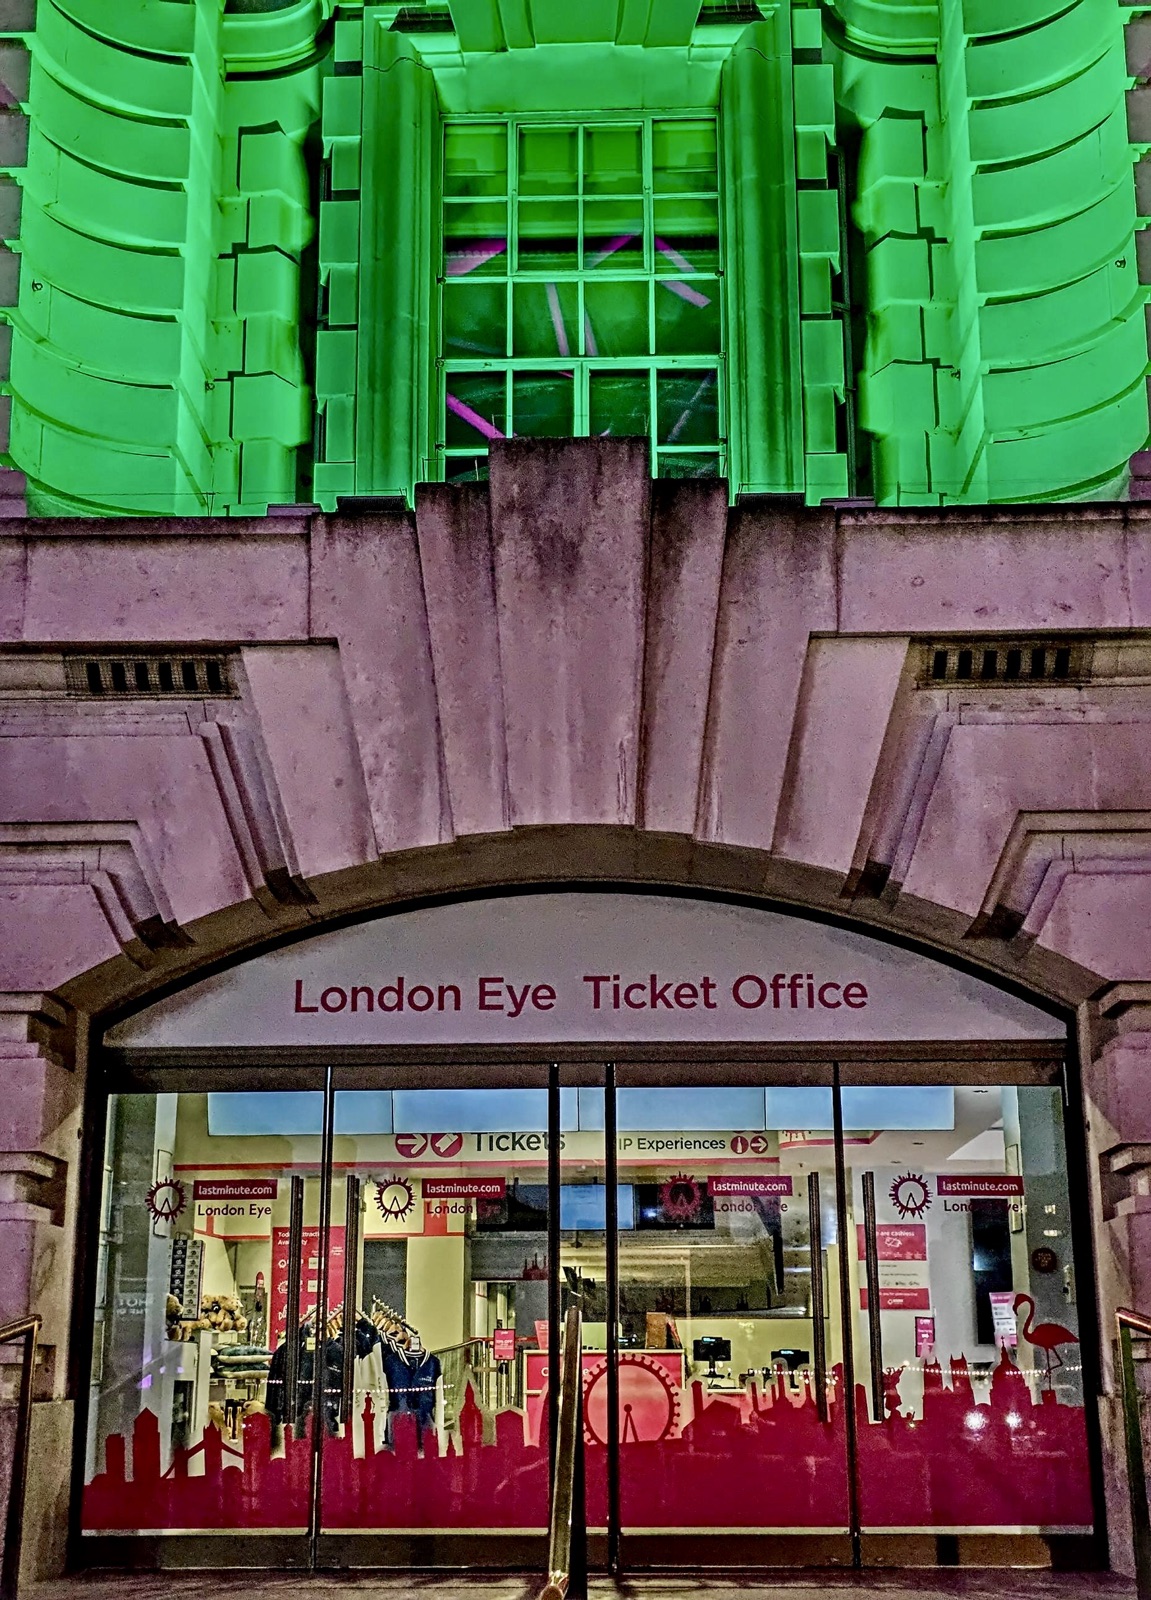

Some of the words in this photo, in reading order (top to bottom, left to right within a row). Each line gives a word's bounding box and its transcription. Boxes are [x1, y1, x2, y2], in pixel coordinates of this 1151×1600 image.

[295, 977, 461, 1013] London
[478, 977, 556, 1018] Eye
[583, 974, 717, 1009] Ticket
[732, 973, 868, 1009] Office
[618, 1138, 633, 1151] IP
[637, 1137, 726, 1152] Experiences
[198, 1185, 273, 1195] lastminute.com
[426, 1183, 501, 1194] lastminute.com
[713, 1181, 787, 1191] lastminute.com
[942, 1181, 1019, 1191] lastminute.com
[198, 1204, 245, 1216] London
[249, 1203, 272, 1219] Eye
[426, 1202, 473, 1214] London
